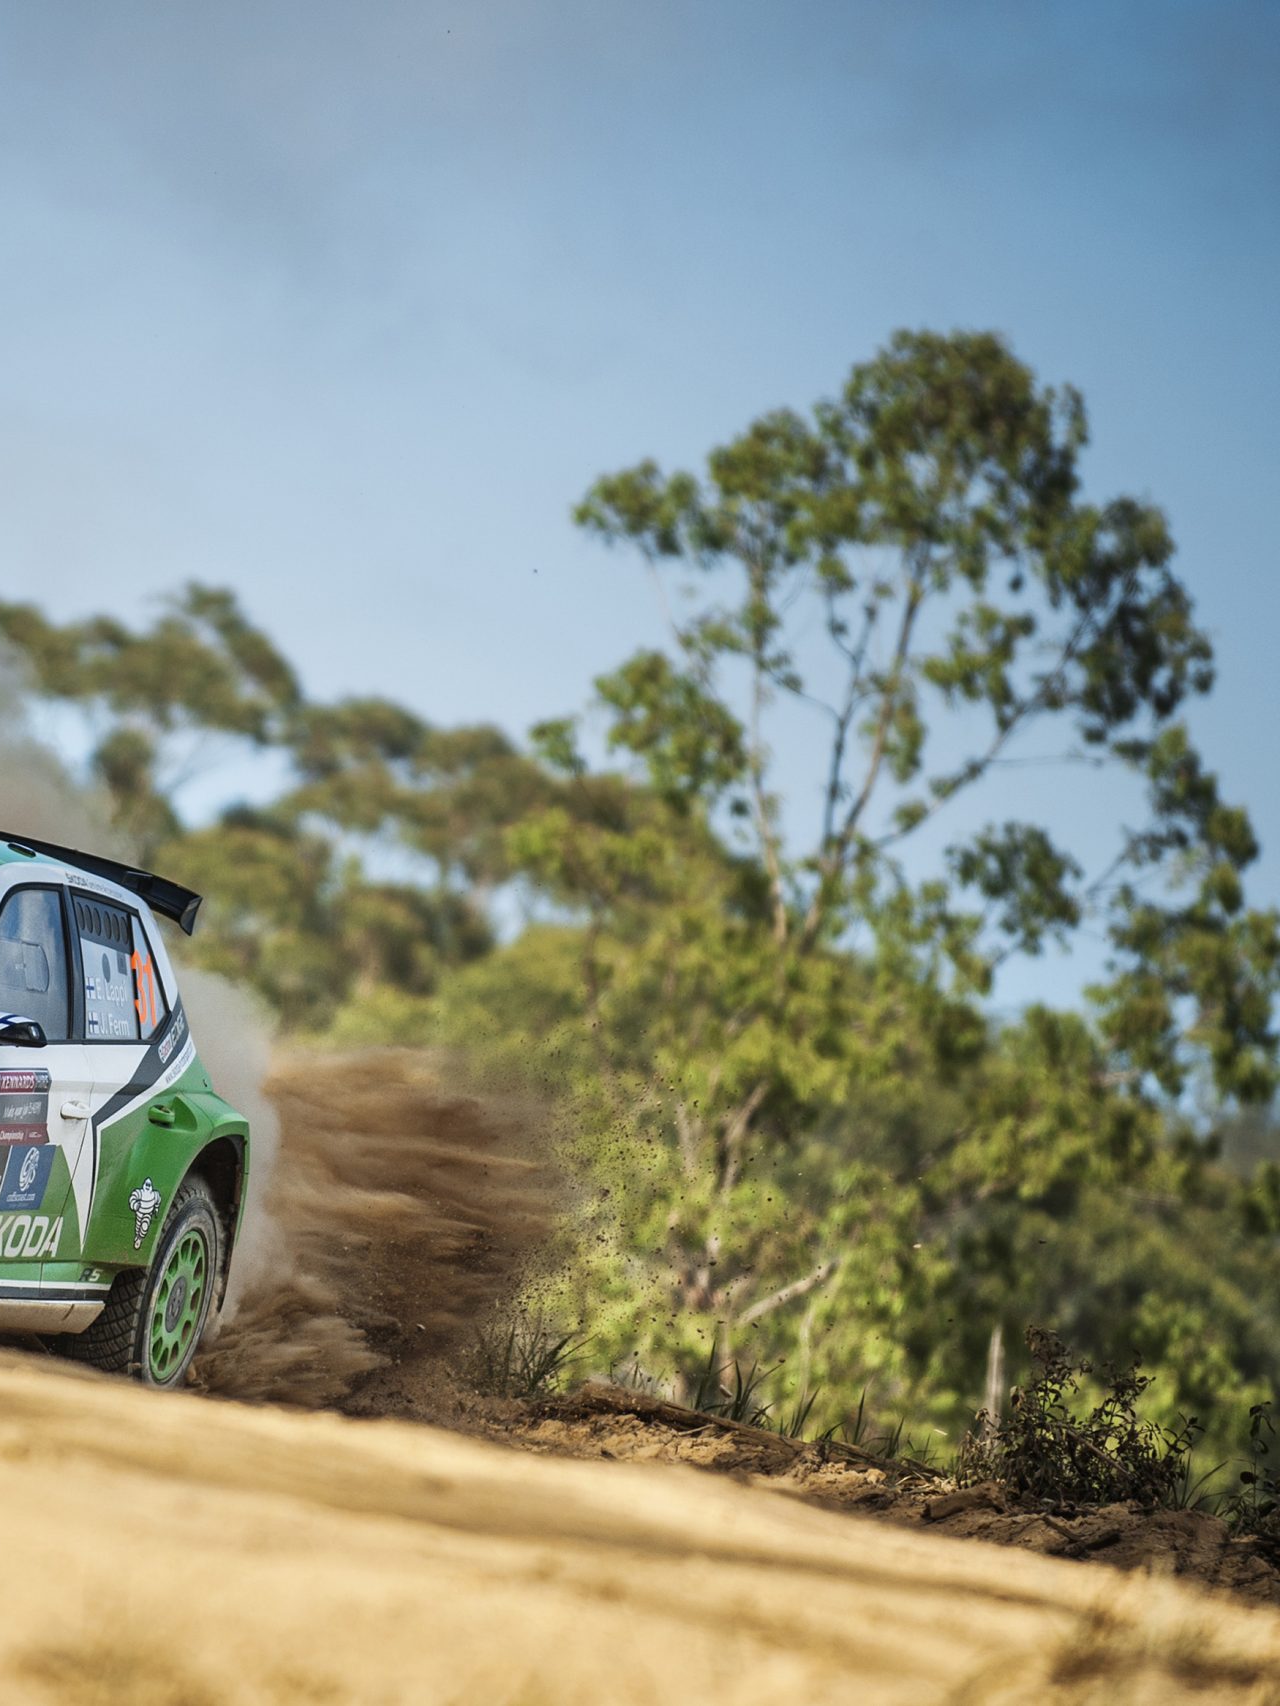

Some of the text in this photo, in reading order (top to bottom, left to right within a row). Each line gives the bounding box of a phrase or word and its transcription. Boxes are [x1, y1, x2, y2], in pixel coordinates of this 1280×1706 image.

[105, 978, 128, 1008] Lappi
[130, 949, 157, 1028] 31
[108, 1013, 130, 1036] Ferm
[0, 1075, 35, 1089] KENNARDS
[80, 1268, 103, 1282] R5
